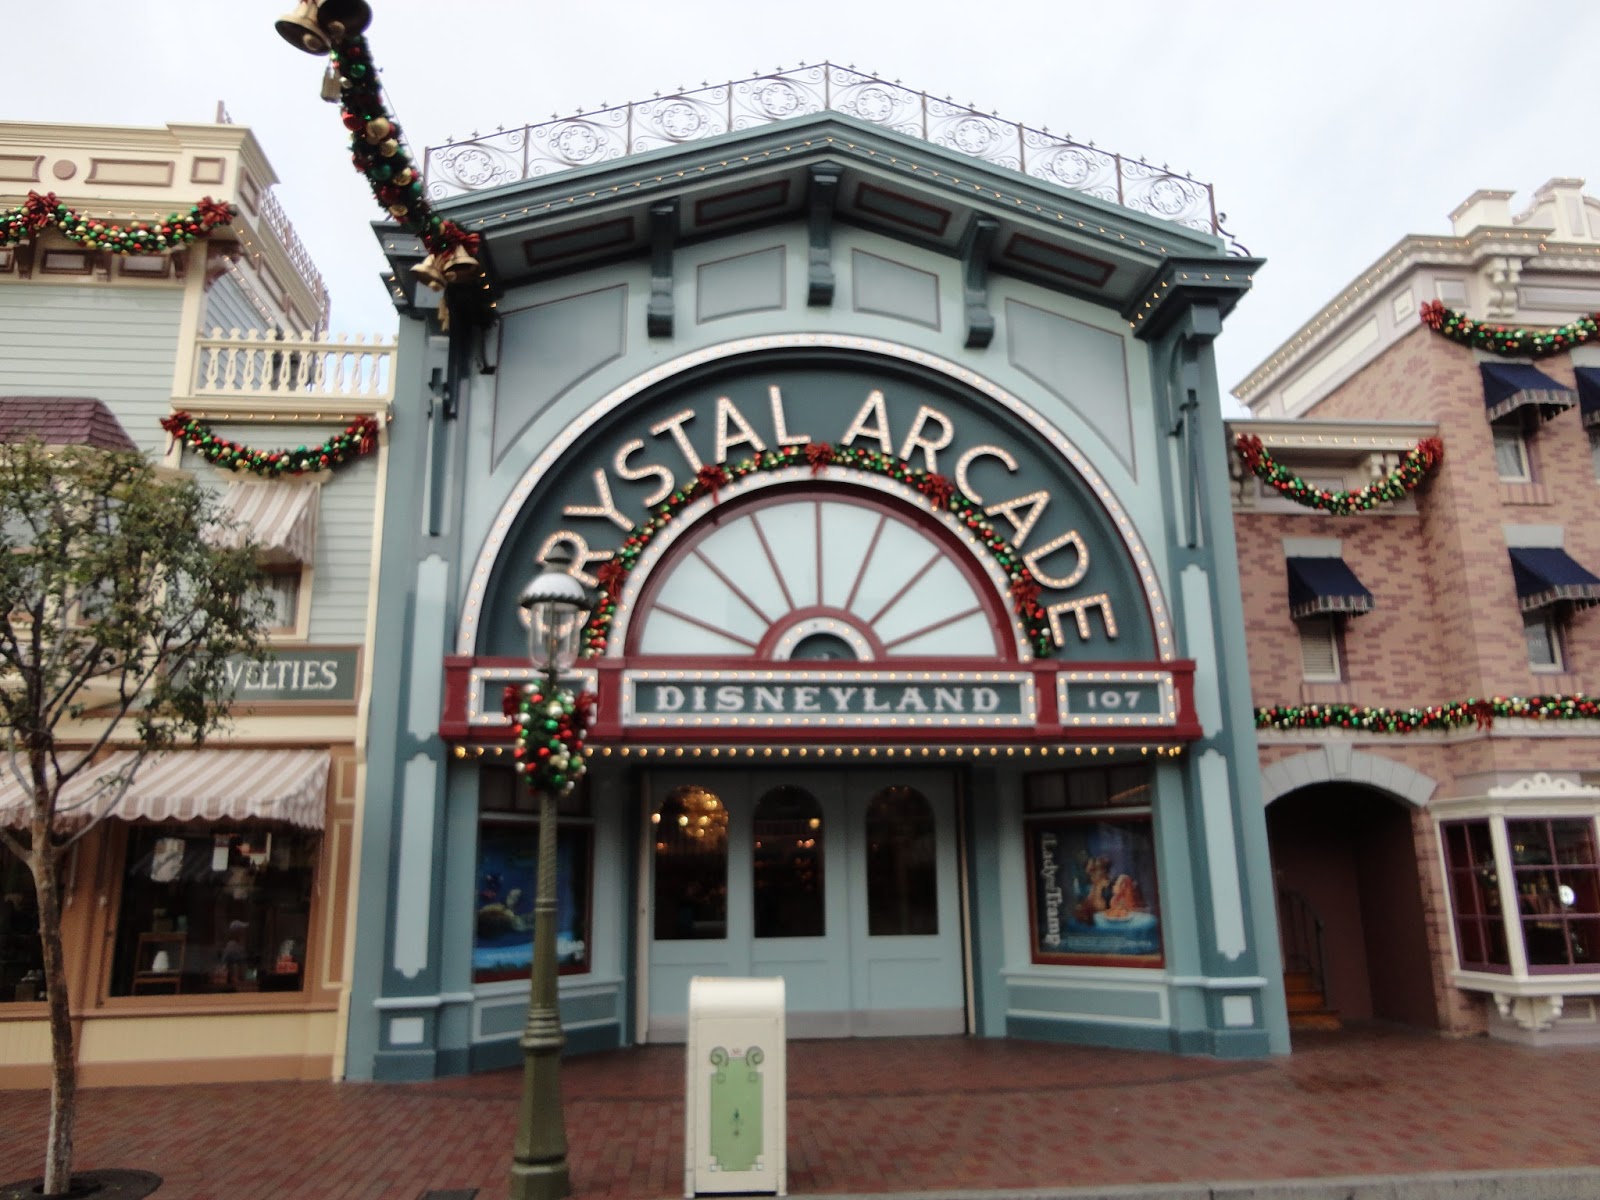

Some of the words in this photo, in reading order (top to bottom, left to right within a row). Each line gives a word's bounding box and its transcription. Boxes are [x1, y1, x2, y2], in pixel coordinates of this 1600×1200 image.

[841, 389, 1118, 647] ARCADE
[187, 659, 338, 691] VELTIES
[656, 684, 999, 712] DISNEYLAND
[1086, 690, 1141, 709] 107
[1041, 836, 1059, 879] Lady
[1044, 887, 1062, 945] Tramp
